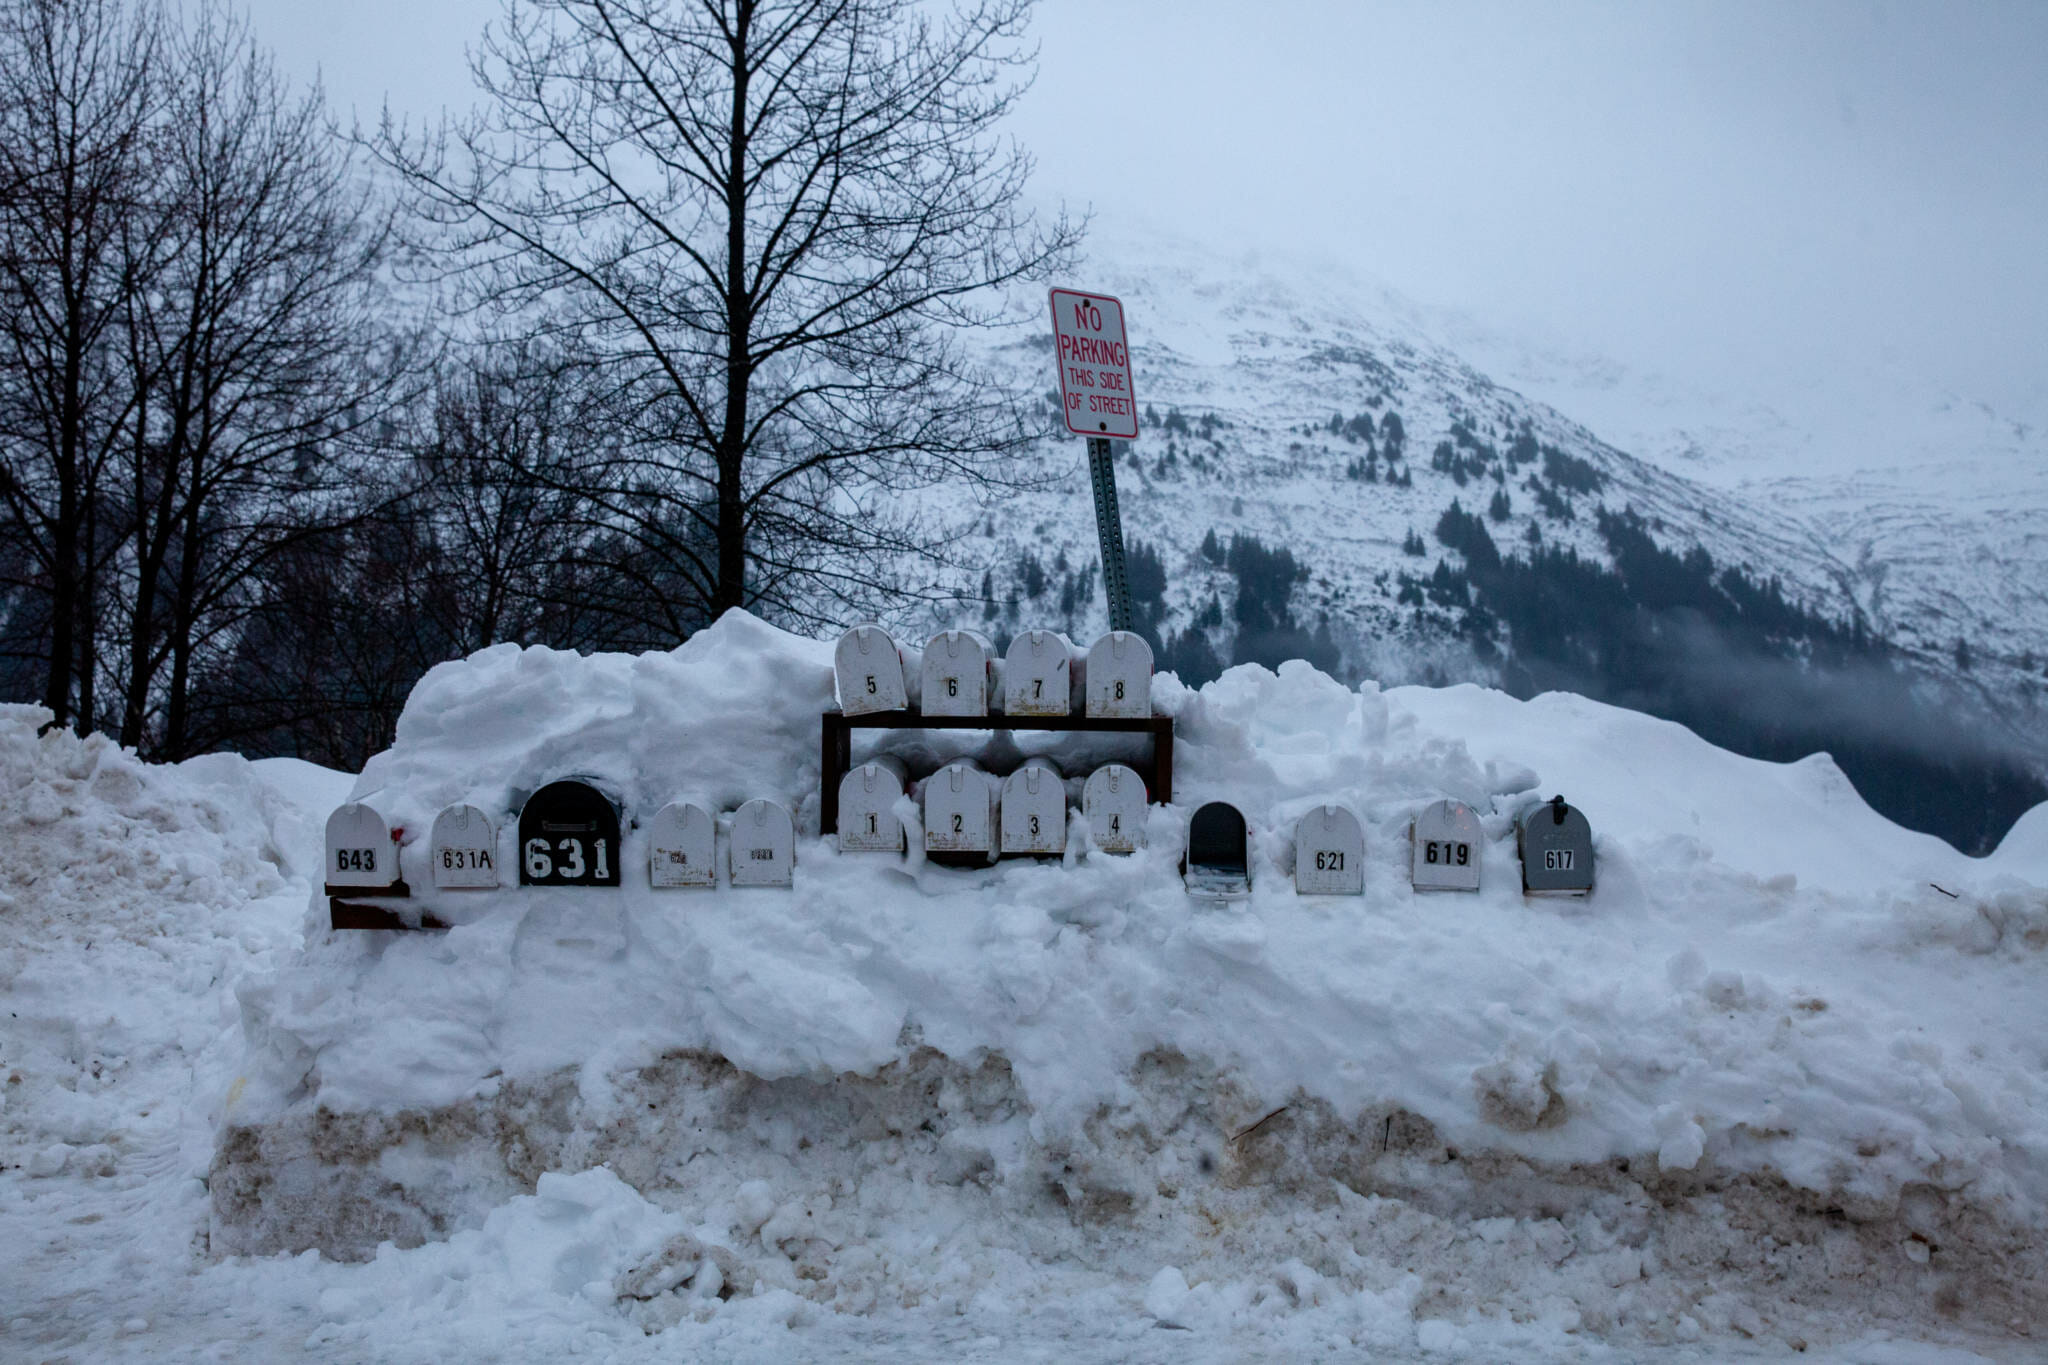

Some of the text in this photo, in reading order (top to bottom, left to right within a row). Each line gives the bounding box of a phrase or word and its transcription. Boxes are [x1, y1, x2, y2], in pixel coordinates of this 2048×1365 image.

[1074, 303, 1102, 332] NO
[1060, 334, 1125, 367] PARKING
[1068, 367, 1125, 391] THIS SIDE
[1067, 392, 1131, 416] OF STREET
[866, 676, 876, 694] 5
[948, 679, 957, 697] 6
[1034, 680, 1043, 698] 7
[1115, 682, 1124, 700] 8
[869, 815, 875, 833] 1
[953, 814, 962, 833] 2
[1030, 816, 1039, 835] 3
[1111, 815, 1120, 833] 4
[338, 850, 375, 870] 643
[443, 850, 492, 869] 631A
[525, 838, 610, 879] 631
[1316, 852, 1345, 871] 621
[1426, 842, 1470, 866] 619
[1546, 850, 1573, 869] 617
